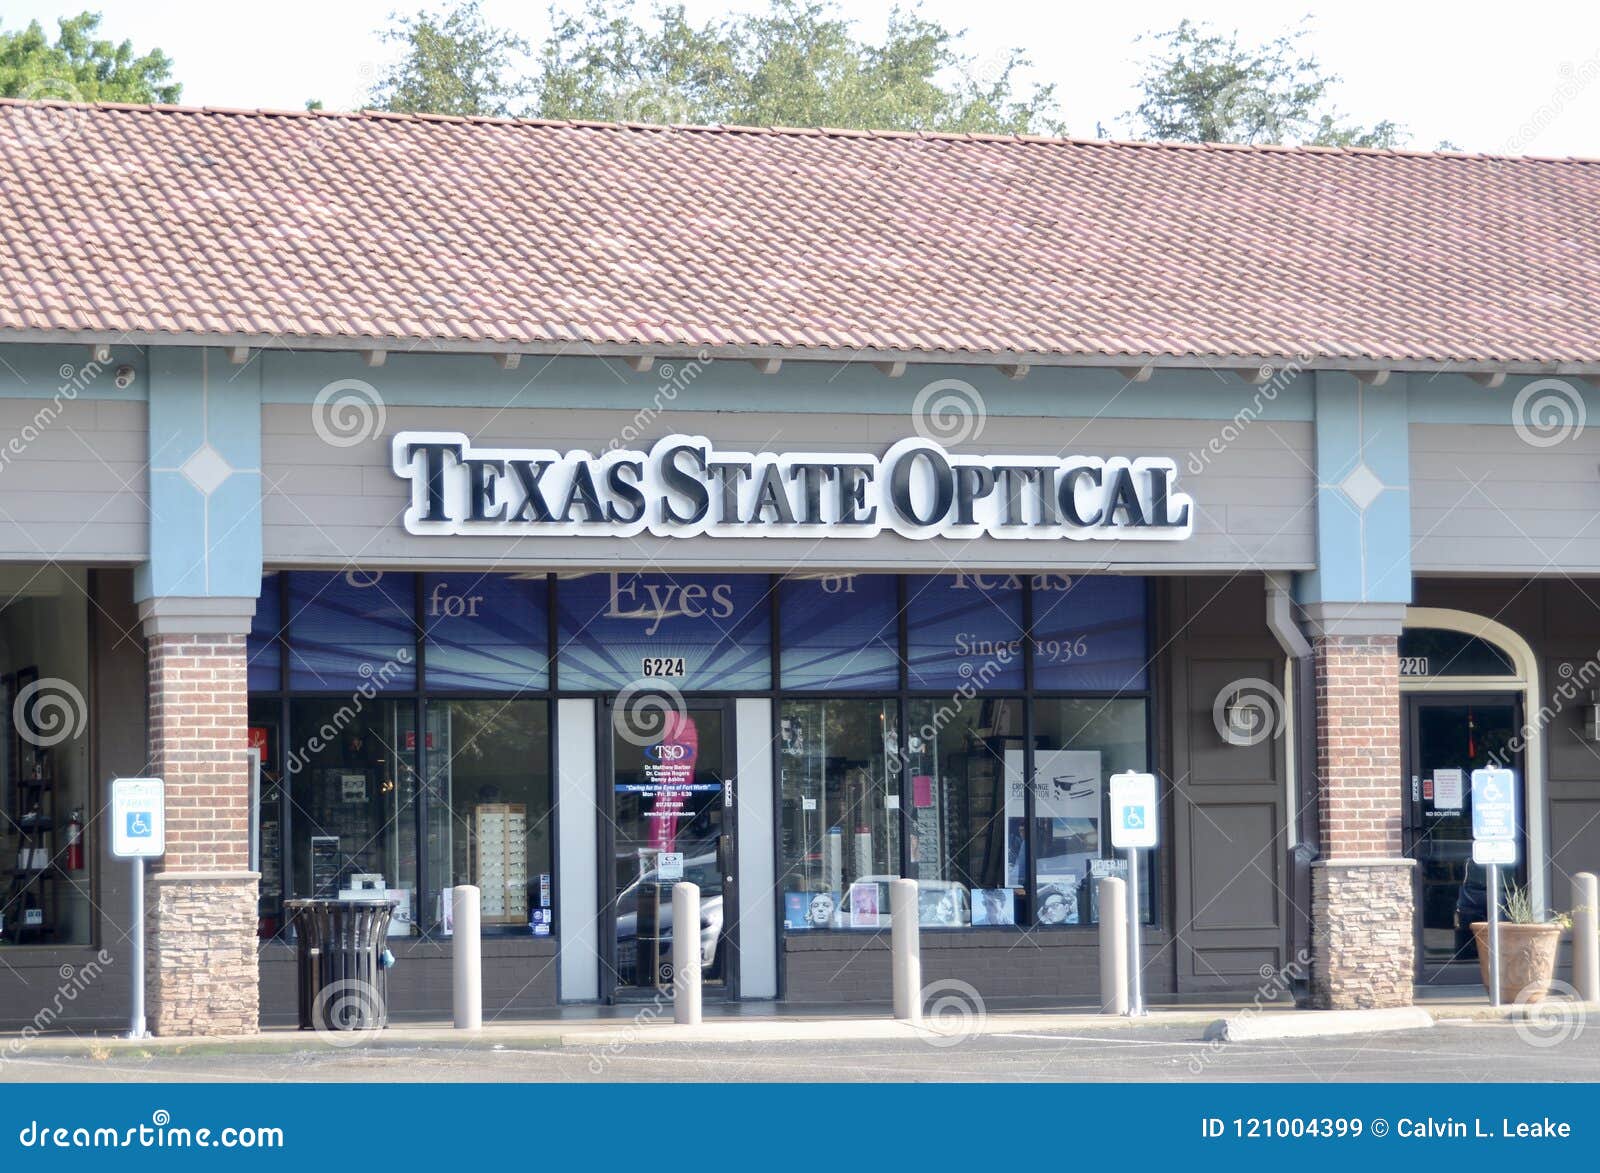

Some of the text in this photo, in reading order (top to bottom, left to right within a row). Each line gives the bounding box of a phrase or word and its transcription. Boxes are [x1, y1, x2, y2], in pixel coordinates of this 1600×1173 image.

[407, 443, 1189, 527] TEXAS STATE OPTICAL
[429, 583, 484, 617] for
[604, 573, 734, 635] Eyes
[955, 632, 1087, 662] Since 1936
[643, 658, 684, 676] 6224
[655, 745, 684, 759] TSO
